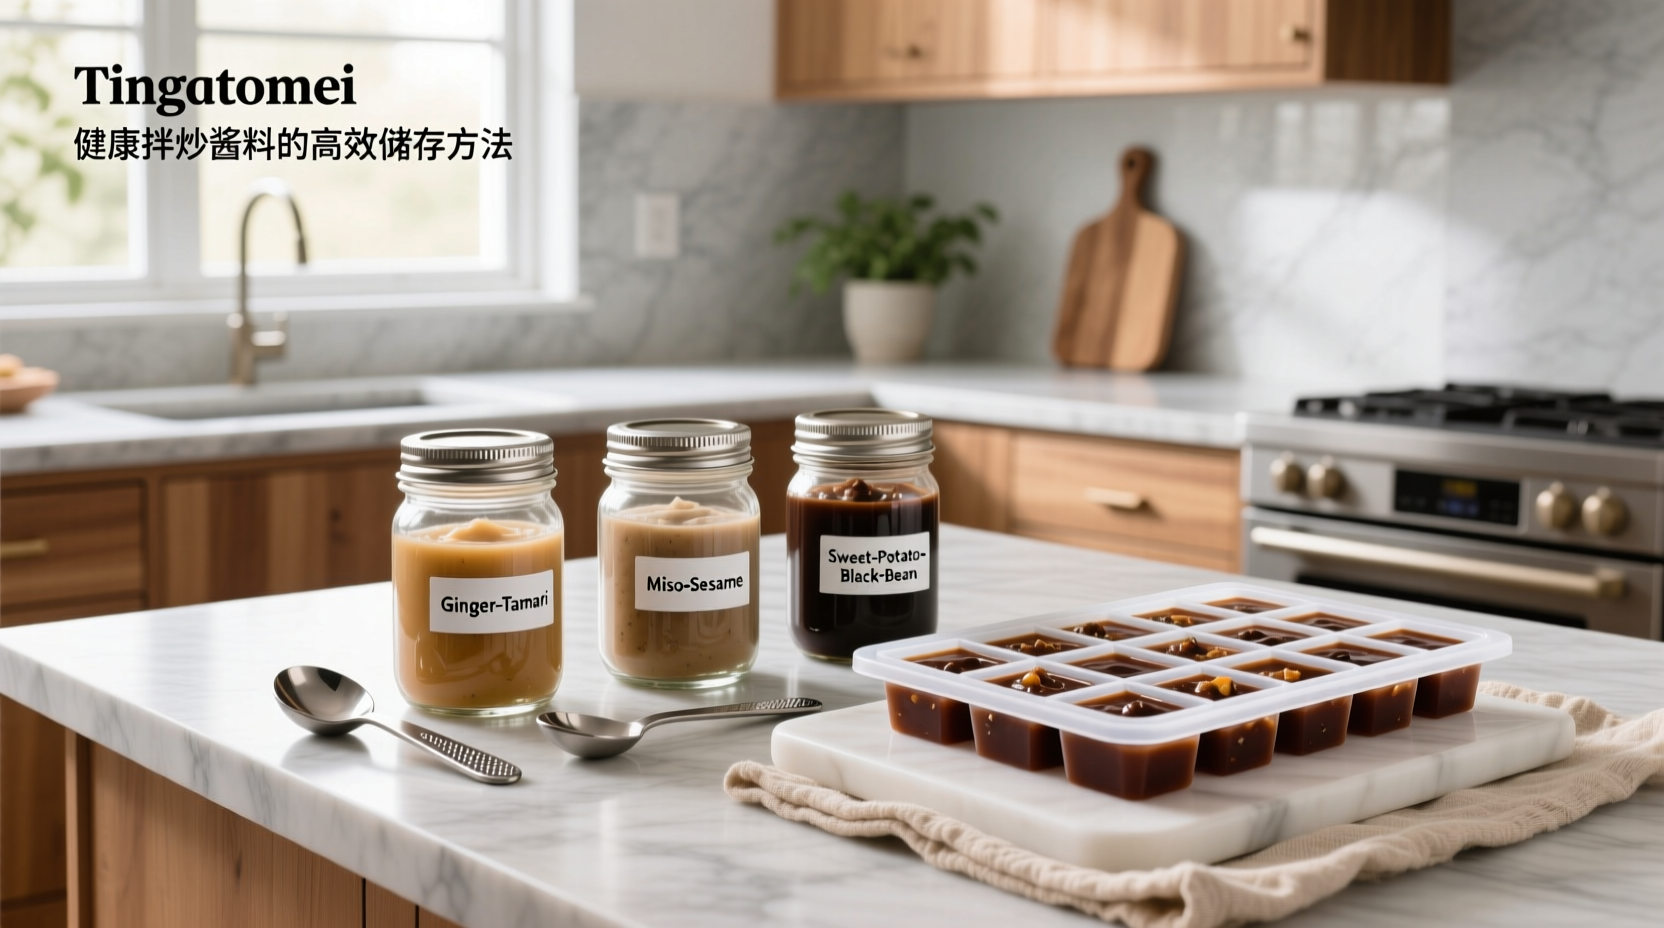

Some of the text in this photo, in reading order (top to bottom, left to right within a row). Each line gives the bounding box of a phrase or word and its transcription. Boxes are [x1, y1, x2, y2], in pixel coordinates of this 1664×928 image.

[828, 548, 926, 564] Sweet-Potato-
[840, 567, 918, 583] Black-Bean
[646, 575, 744, 592] Miso-Sesame
[440, 589, 548, 618] Ginger-Tamari
